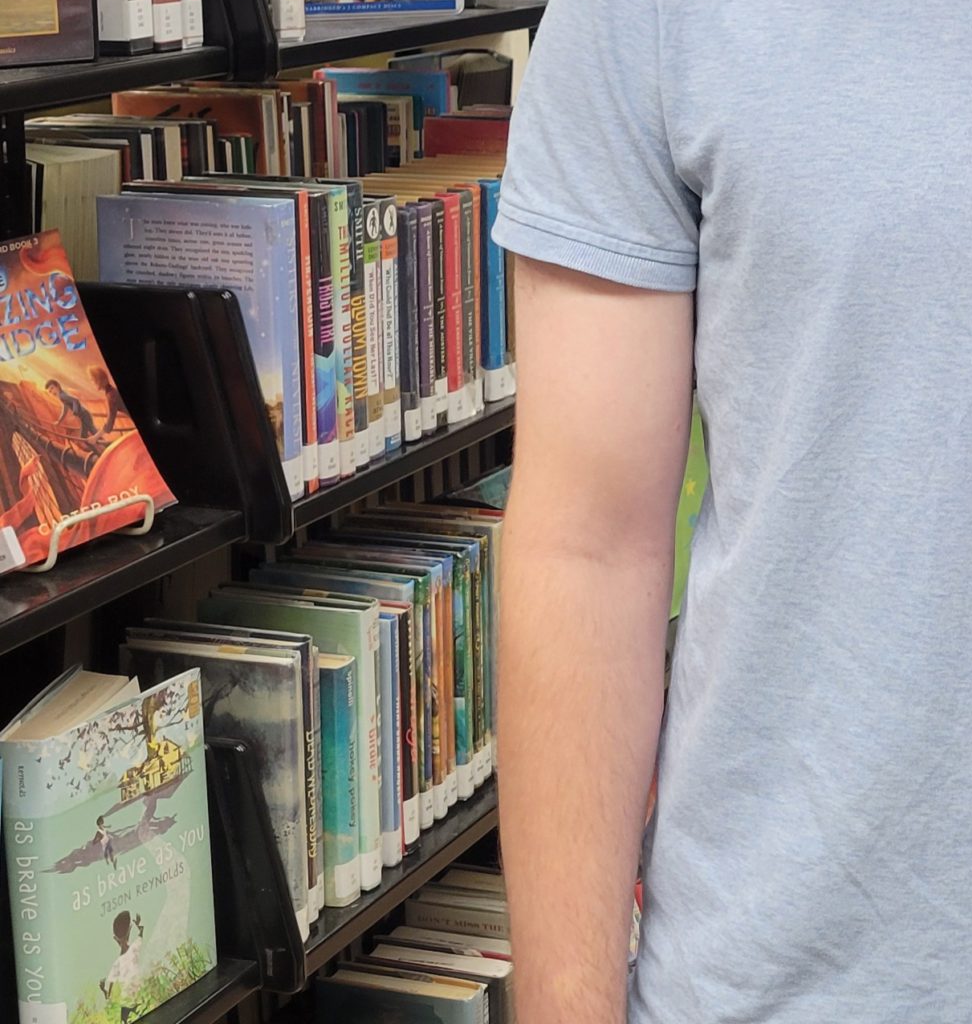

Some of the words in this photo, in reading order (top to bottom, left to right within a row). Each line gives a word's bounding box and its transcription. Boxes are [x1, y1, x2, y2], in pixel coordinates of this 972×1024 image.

[9, 239, 33, 251] BOOK
[353, 207, 364, 261] SMITH
[0, 272, 79, 326] ZING
[417, 914, 450, 926] DON'T
[453, 918, 480, 928] MISS
